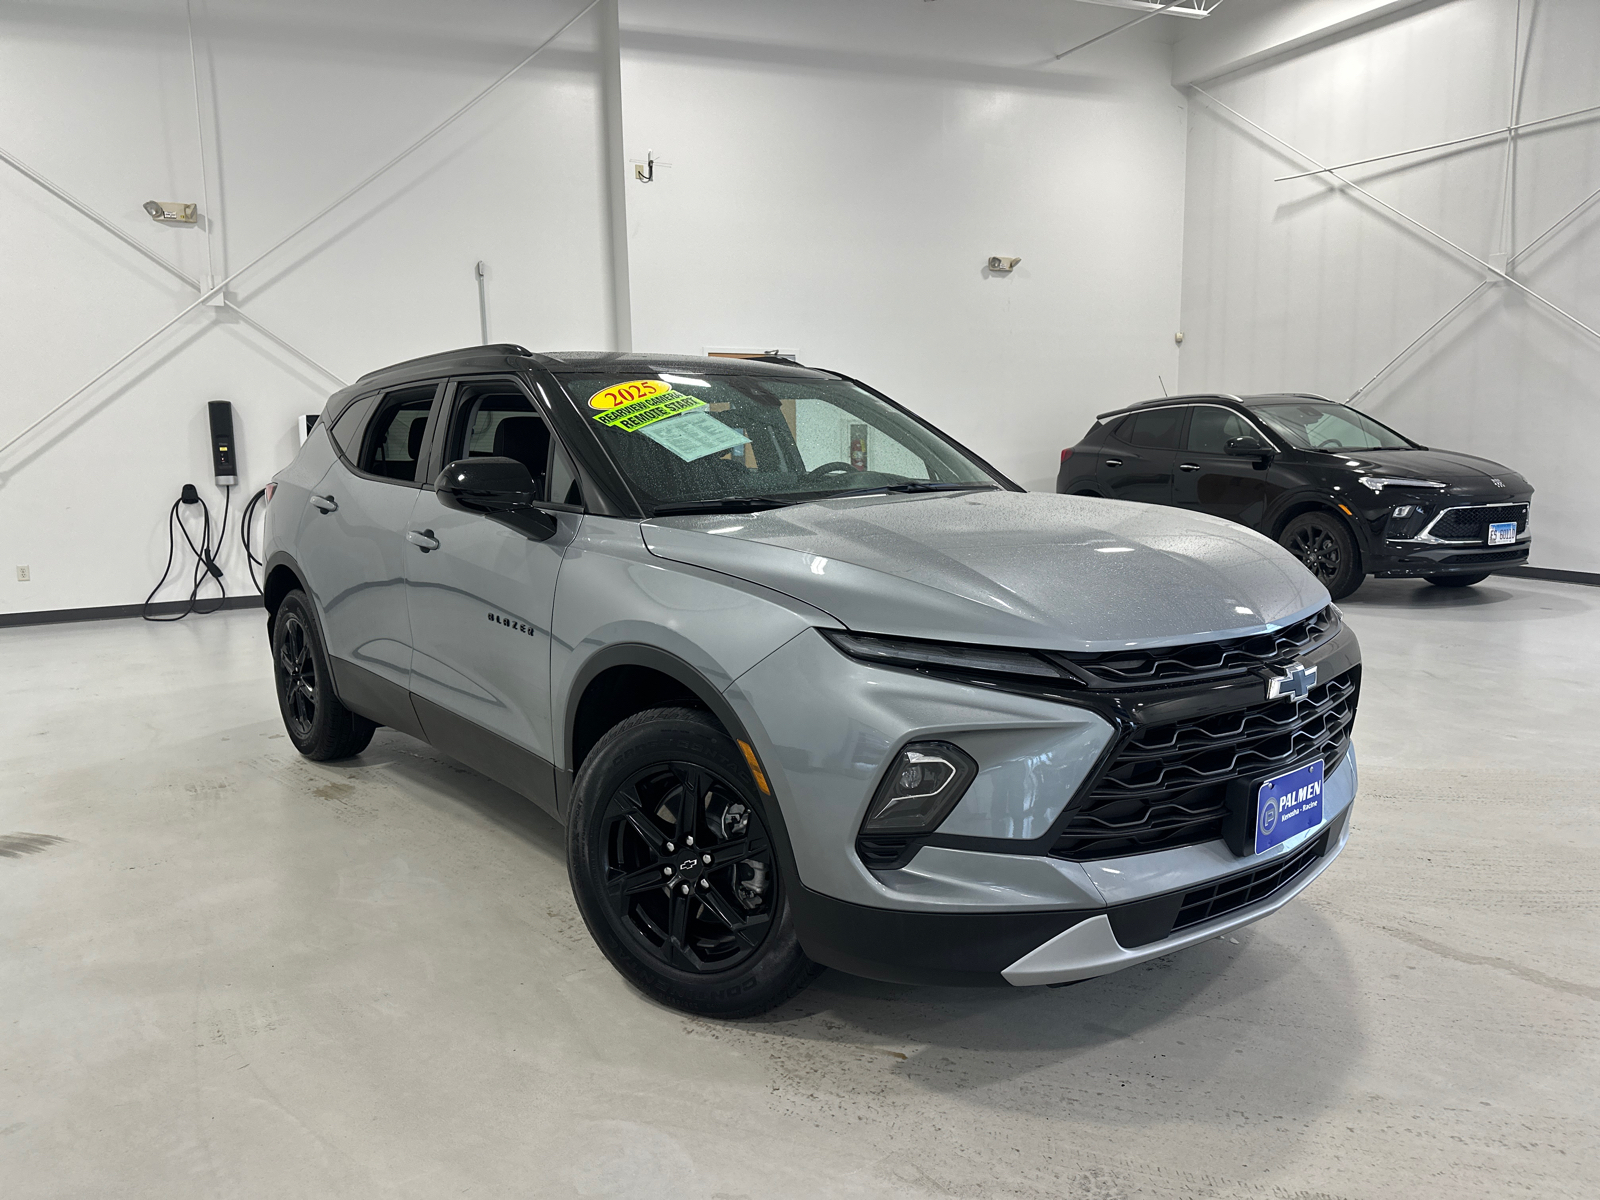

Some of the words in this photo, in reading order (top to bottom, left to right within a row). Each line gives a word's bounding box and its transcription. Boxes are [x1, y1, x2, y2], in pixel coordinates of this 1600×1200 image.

[598, 401, 647, 424] REARVIEW
[645, 390, 684, 407] CAMERA
[604, 381, 657, 407] 2025
[620, 406, 668, 429] REMOTE
[663, 397, 698, 412] START
[487, 612, 535, 637] BLAZER
[1279, 780, 1321, 813] PALMEN
[1281, 808, 1300, 823] Kenosha
[1302, 800, 1318, 812] Racine
